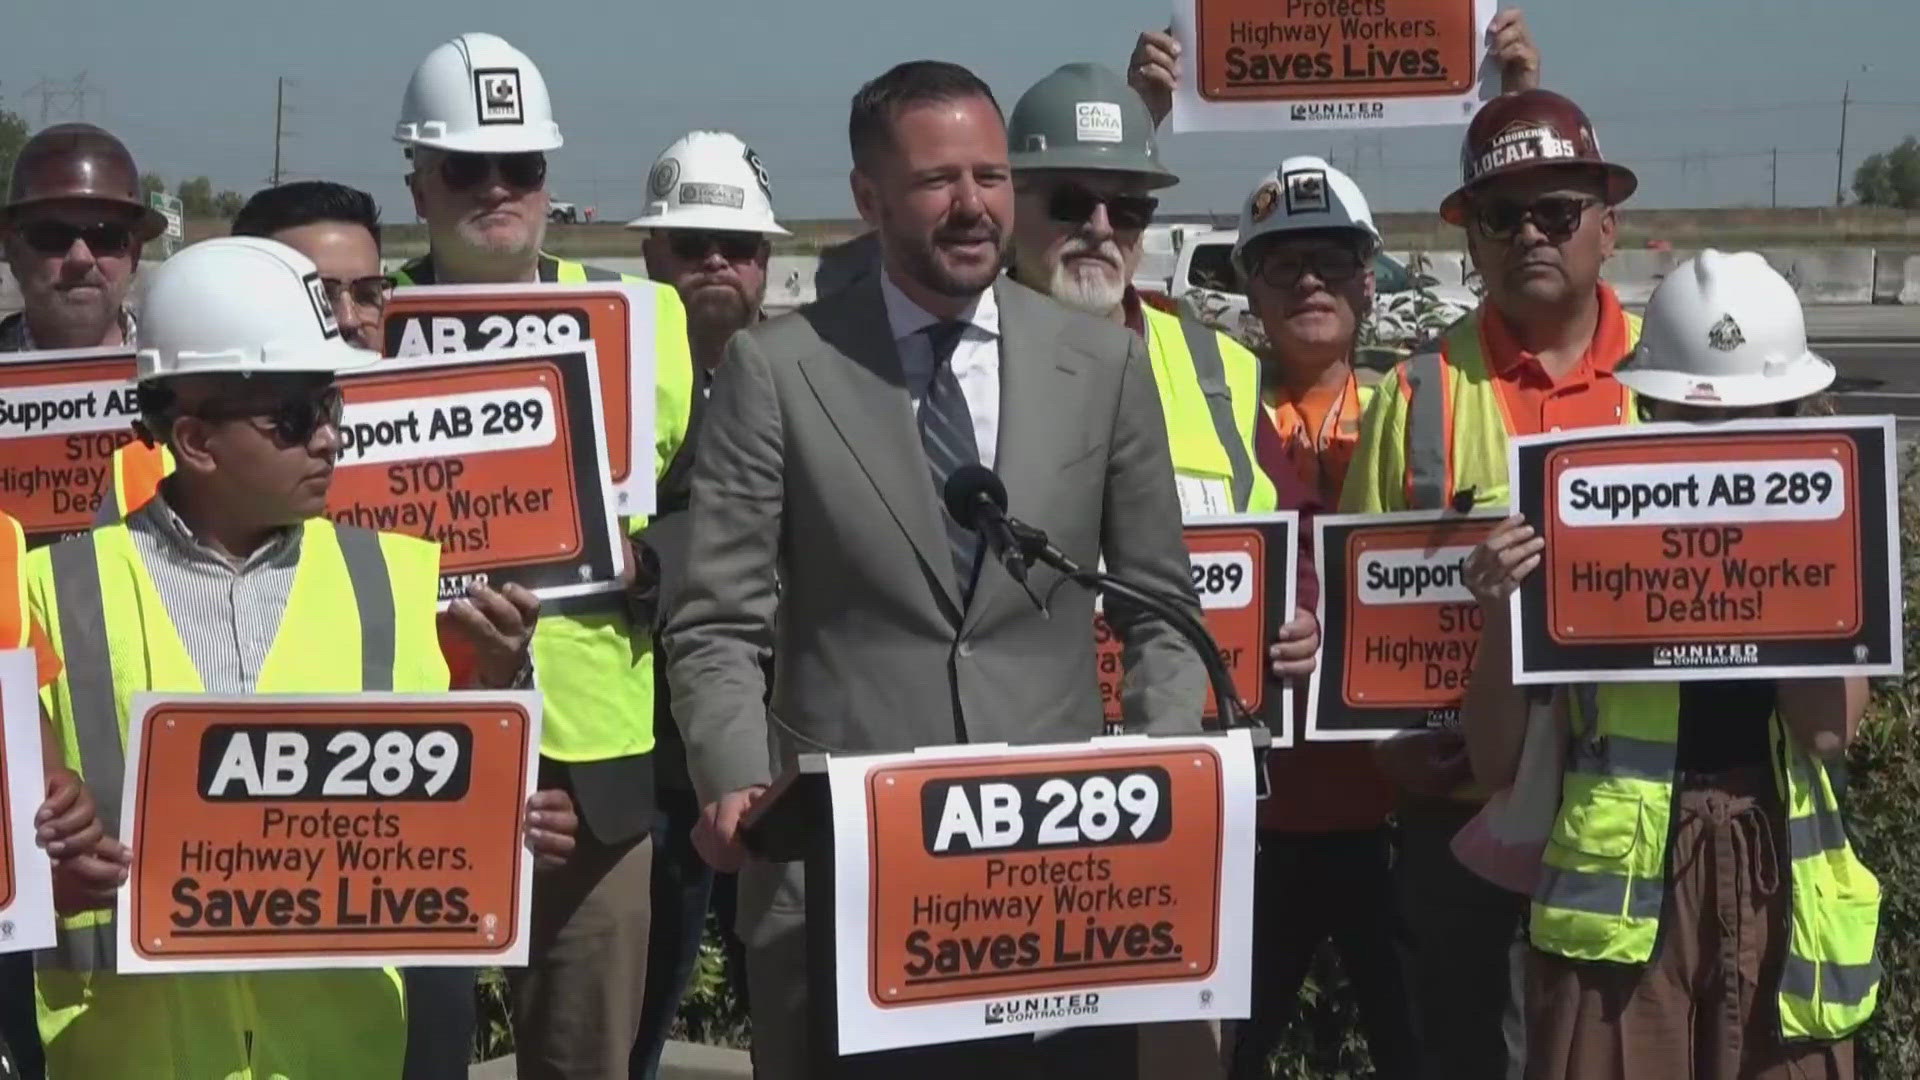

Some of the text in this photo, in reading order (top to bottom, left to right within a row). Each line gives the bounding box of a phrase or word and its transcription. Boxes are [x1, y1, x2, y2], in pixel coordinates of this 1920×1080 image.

[1286, 0, 1385, 18] Protects
[1230, 18, 1440, 48] Highway Workers.
[1225, 44, 1448, 82] Saves Lives.
[1079, 117, 1120, 129] CIMA
[1308, 103, 1384, 114] UNITED
[1308, 111, 1384, 121] CONTRACTORS
[1473, 140, 1535, 177] LOCAL
[396, 316, 468, 358] AB
[336, 399, 543, 460] pport AB 289
[388, 459, 464, 495] STOP
[1570, 471, 1833, 519] Support AB 289
[446, 486, 553, 521] Worker
[1662, 527, 1743, 560] STOP
[1190, 562, 1243, 594] 289
[1366, 557, 1465, 598] Support
[1571, 558, 1836, 601] Highway Worker
[1439, 605, 1484, 632] STO
[1646, 590, 1763, 623] Deaths!
[1366, 633, 1479, 673] Highway
[1673, 643, 1758, 657] UNITED
[1673, 655, 1758, 666] CONTRACTORS
[207, 731, 459, 797] AB 289
[263, 807, 400, 838] Protects
[933, 774, 1160, 852] AB 289
[181, 840, 474, 881] Highway Workers.
[986, 853, 1111, 889] Protects
[170, 877, 480, 929] Saves Lives.
[912, 884, 1178, 932] Highway Workers.
[905, 917, 1183, 977] Saves Lives.
[1006, 1005, 1099, 1023] CONTRACTORS
[1007, 993, 1099, 1014] UNITED
